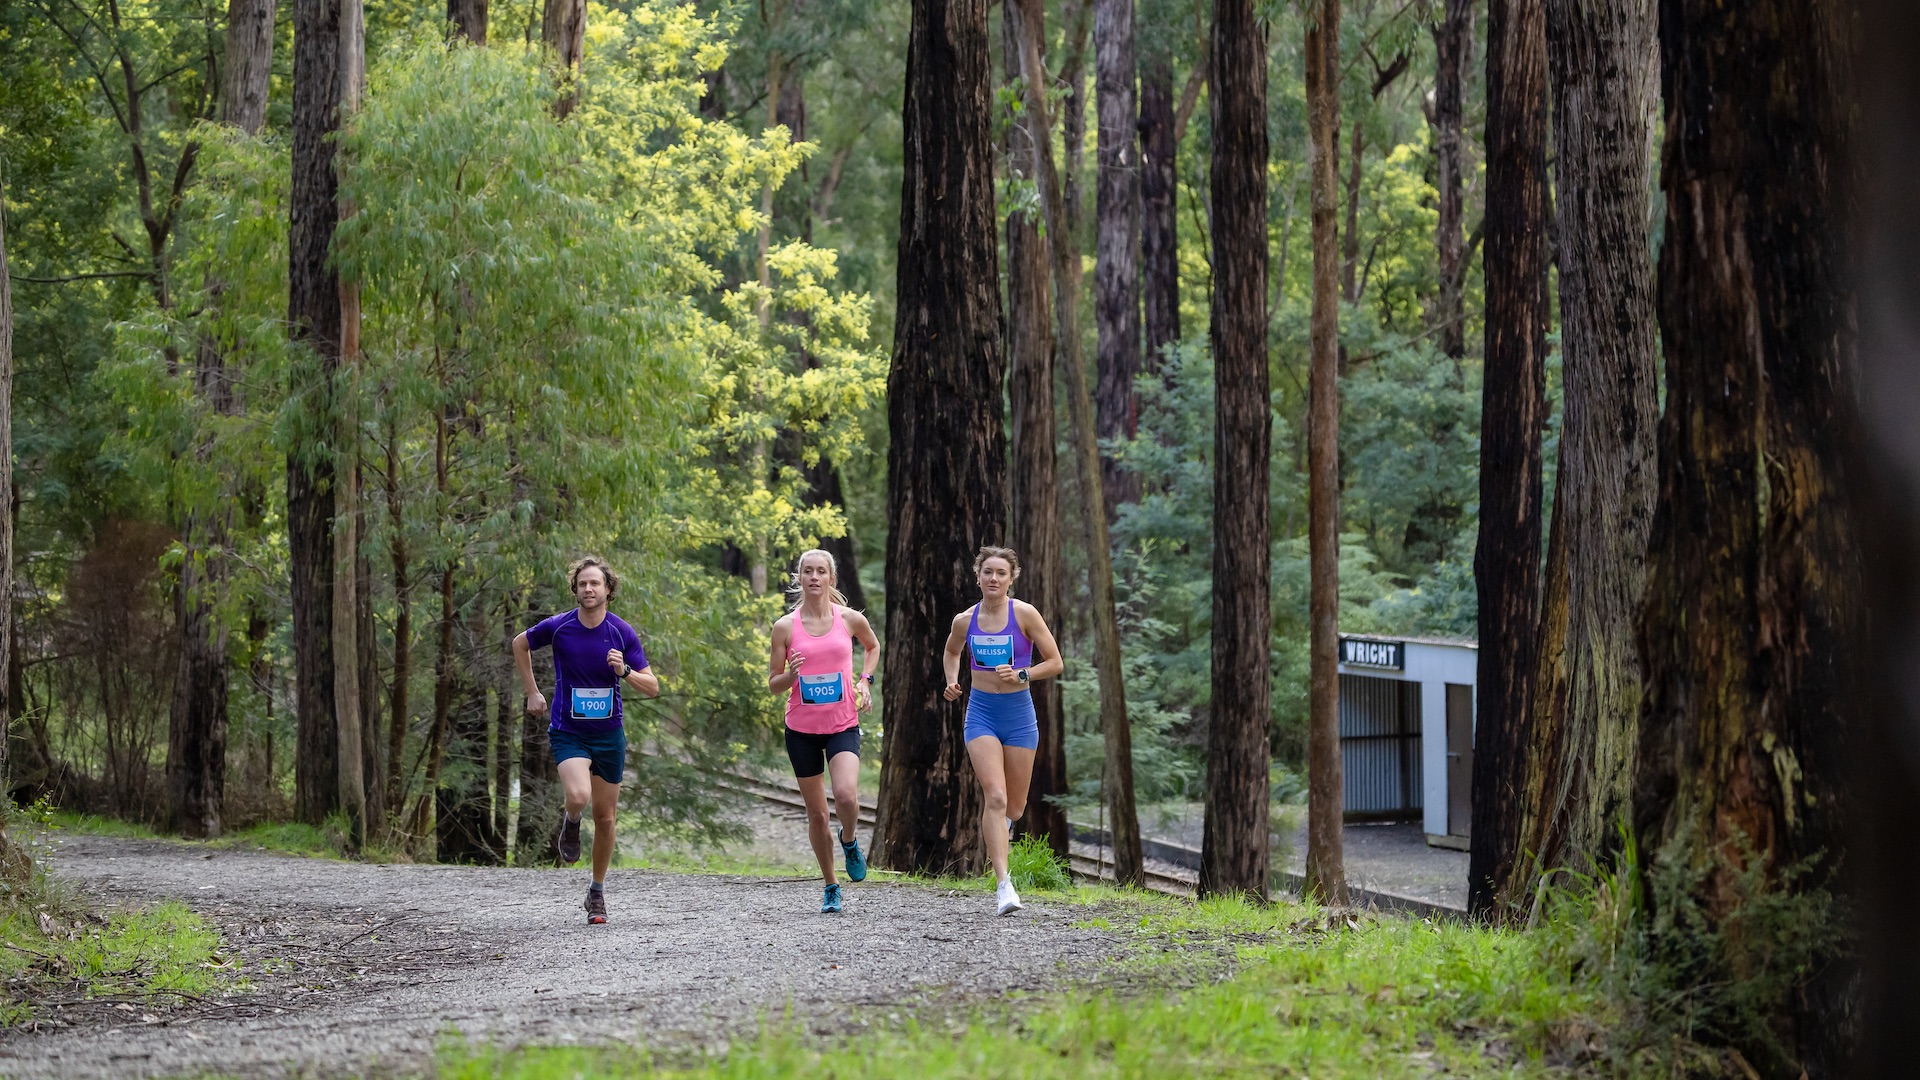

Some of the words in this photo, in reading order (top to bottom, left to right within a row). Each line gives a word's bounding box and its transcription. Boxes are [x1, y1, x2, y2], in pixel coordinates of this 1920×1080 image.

[976, 648, 1007, 656] MELISSA
[1346, 641, 1396, 666] WRIGHT
[808, 685, 835, 697] 1905
[581, 700, 606, 711] 1900
